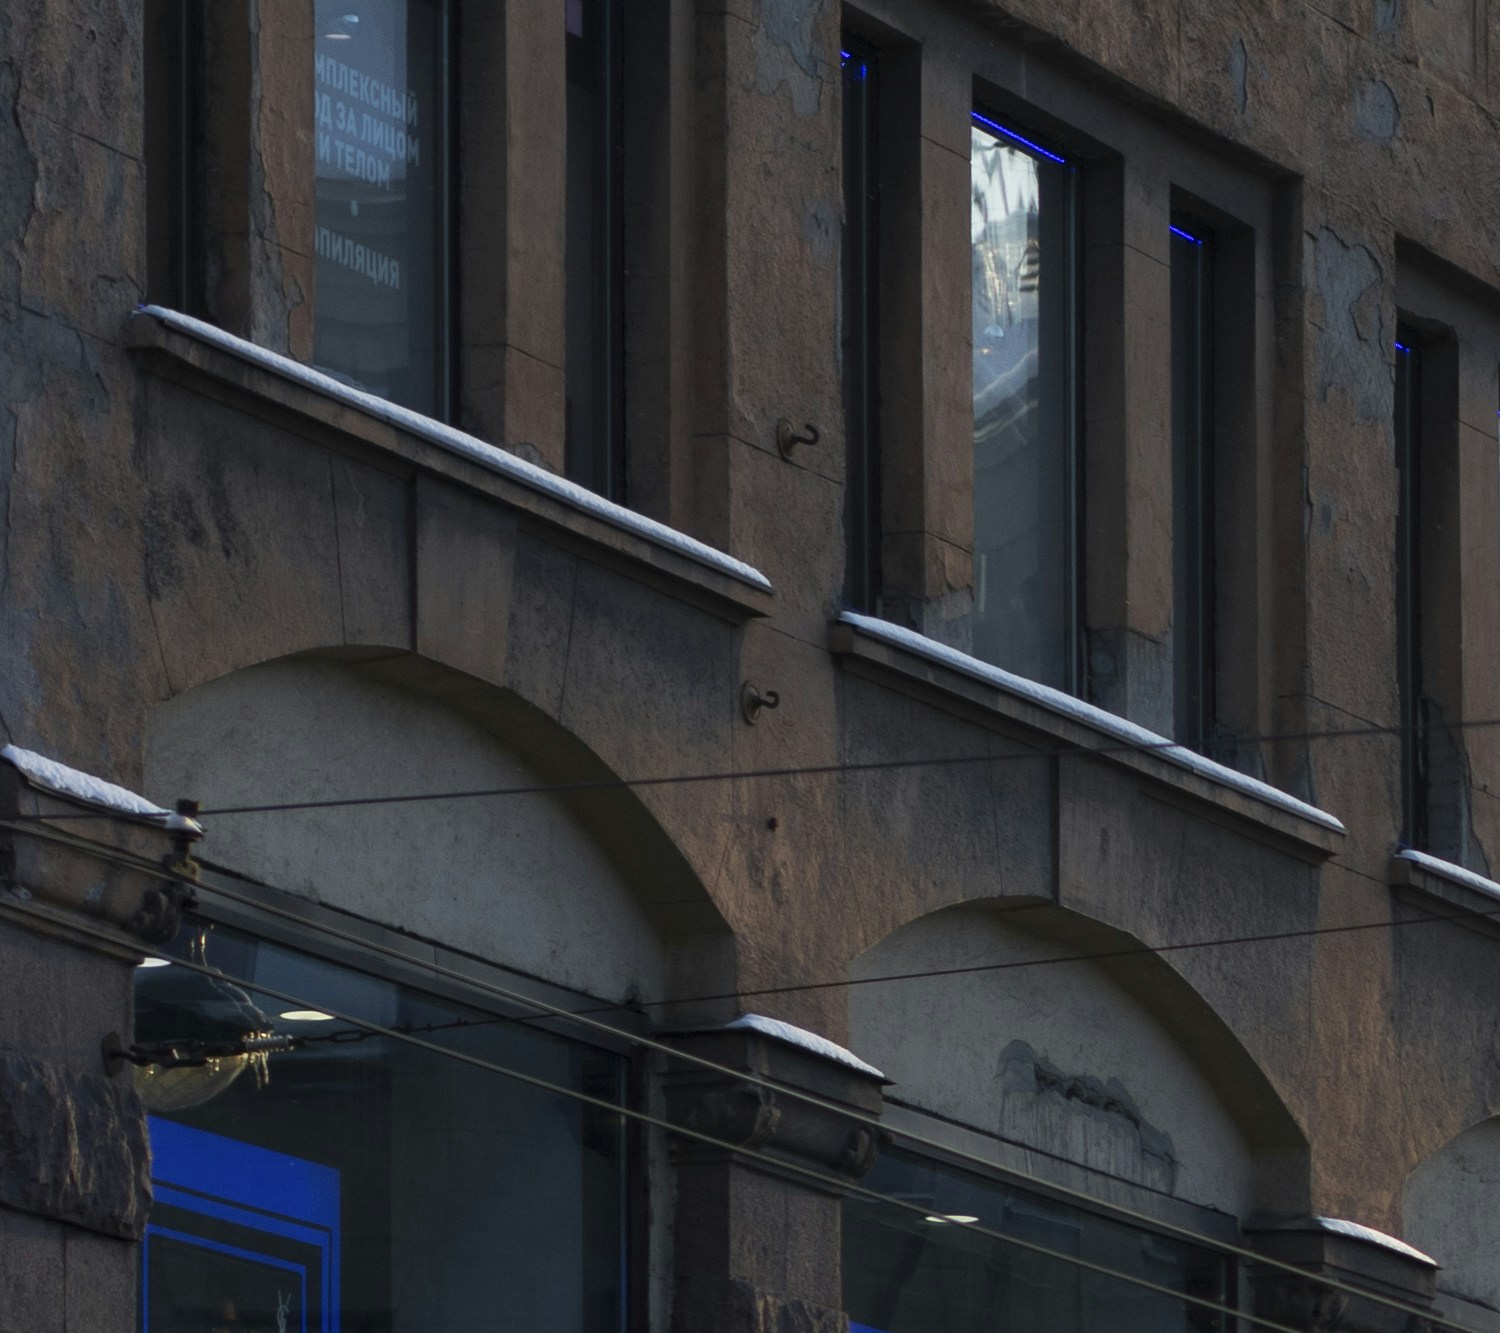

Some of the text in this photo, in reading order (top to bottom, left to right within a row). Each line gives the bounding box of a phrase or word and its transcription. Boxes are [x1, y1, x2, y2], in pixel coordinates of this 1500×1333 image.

[334, 141, 390, 191] ТЕЛОМ
[336, 102, 356, 138] ЗА
[361, 113, 420, 167] ЛИЦОМ
[315, 226, 399, 289] ПИЛЯЦИЯ
